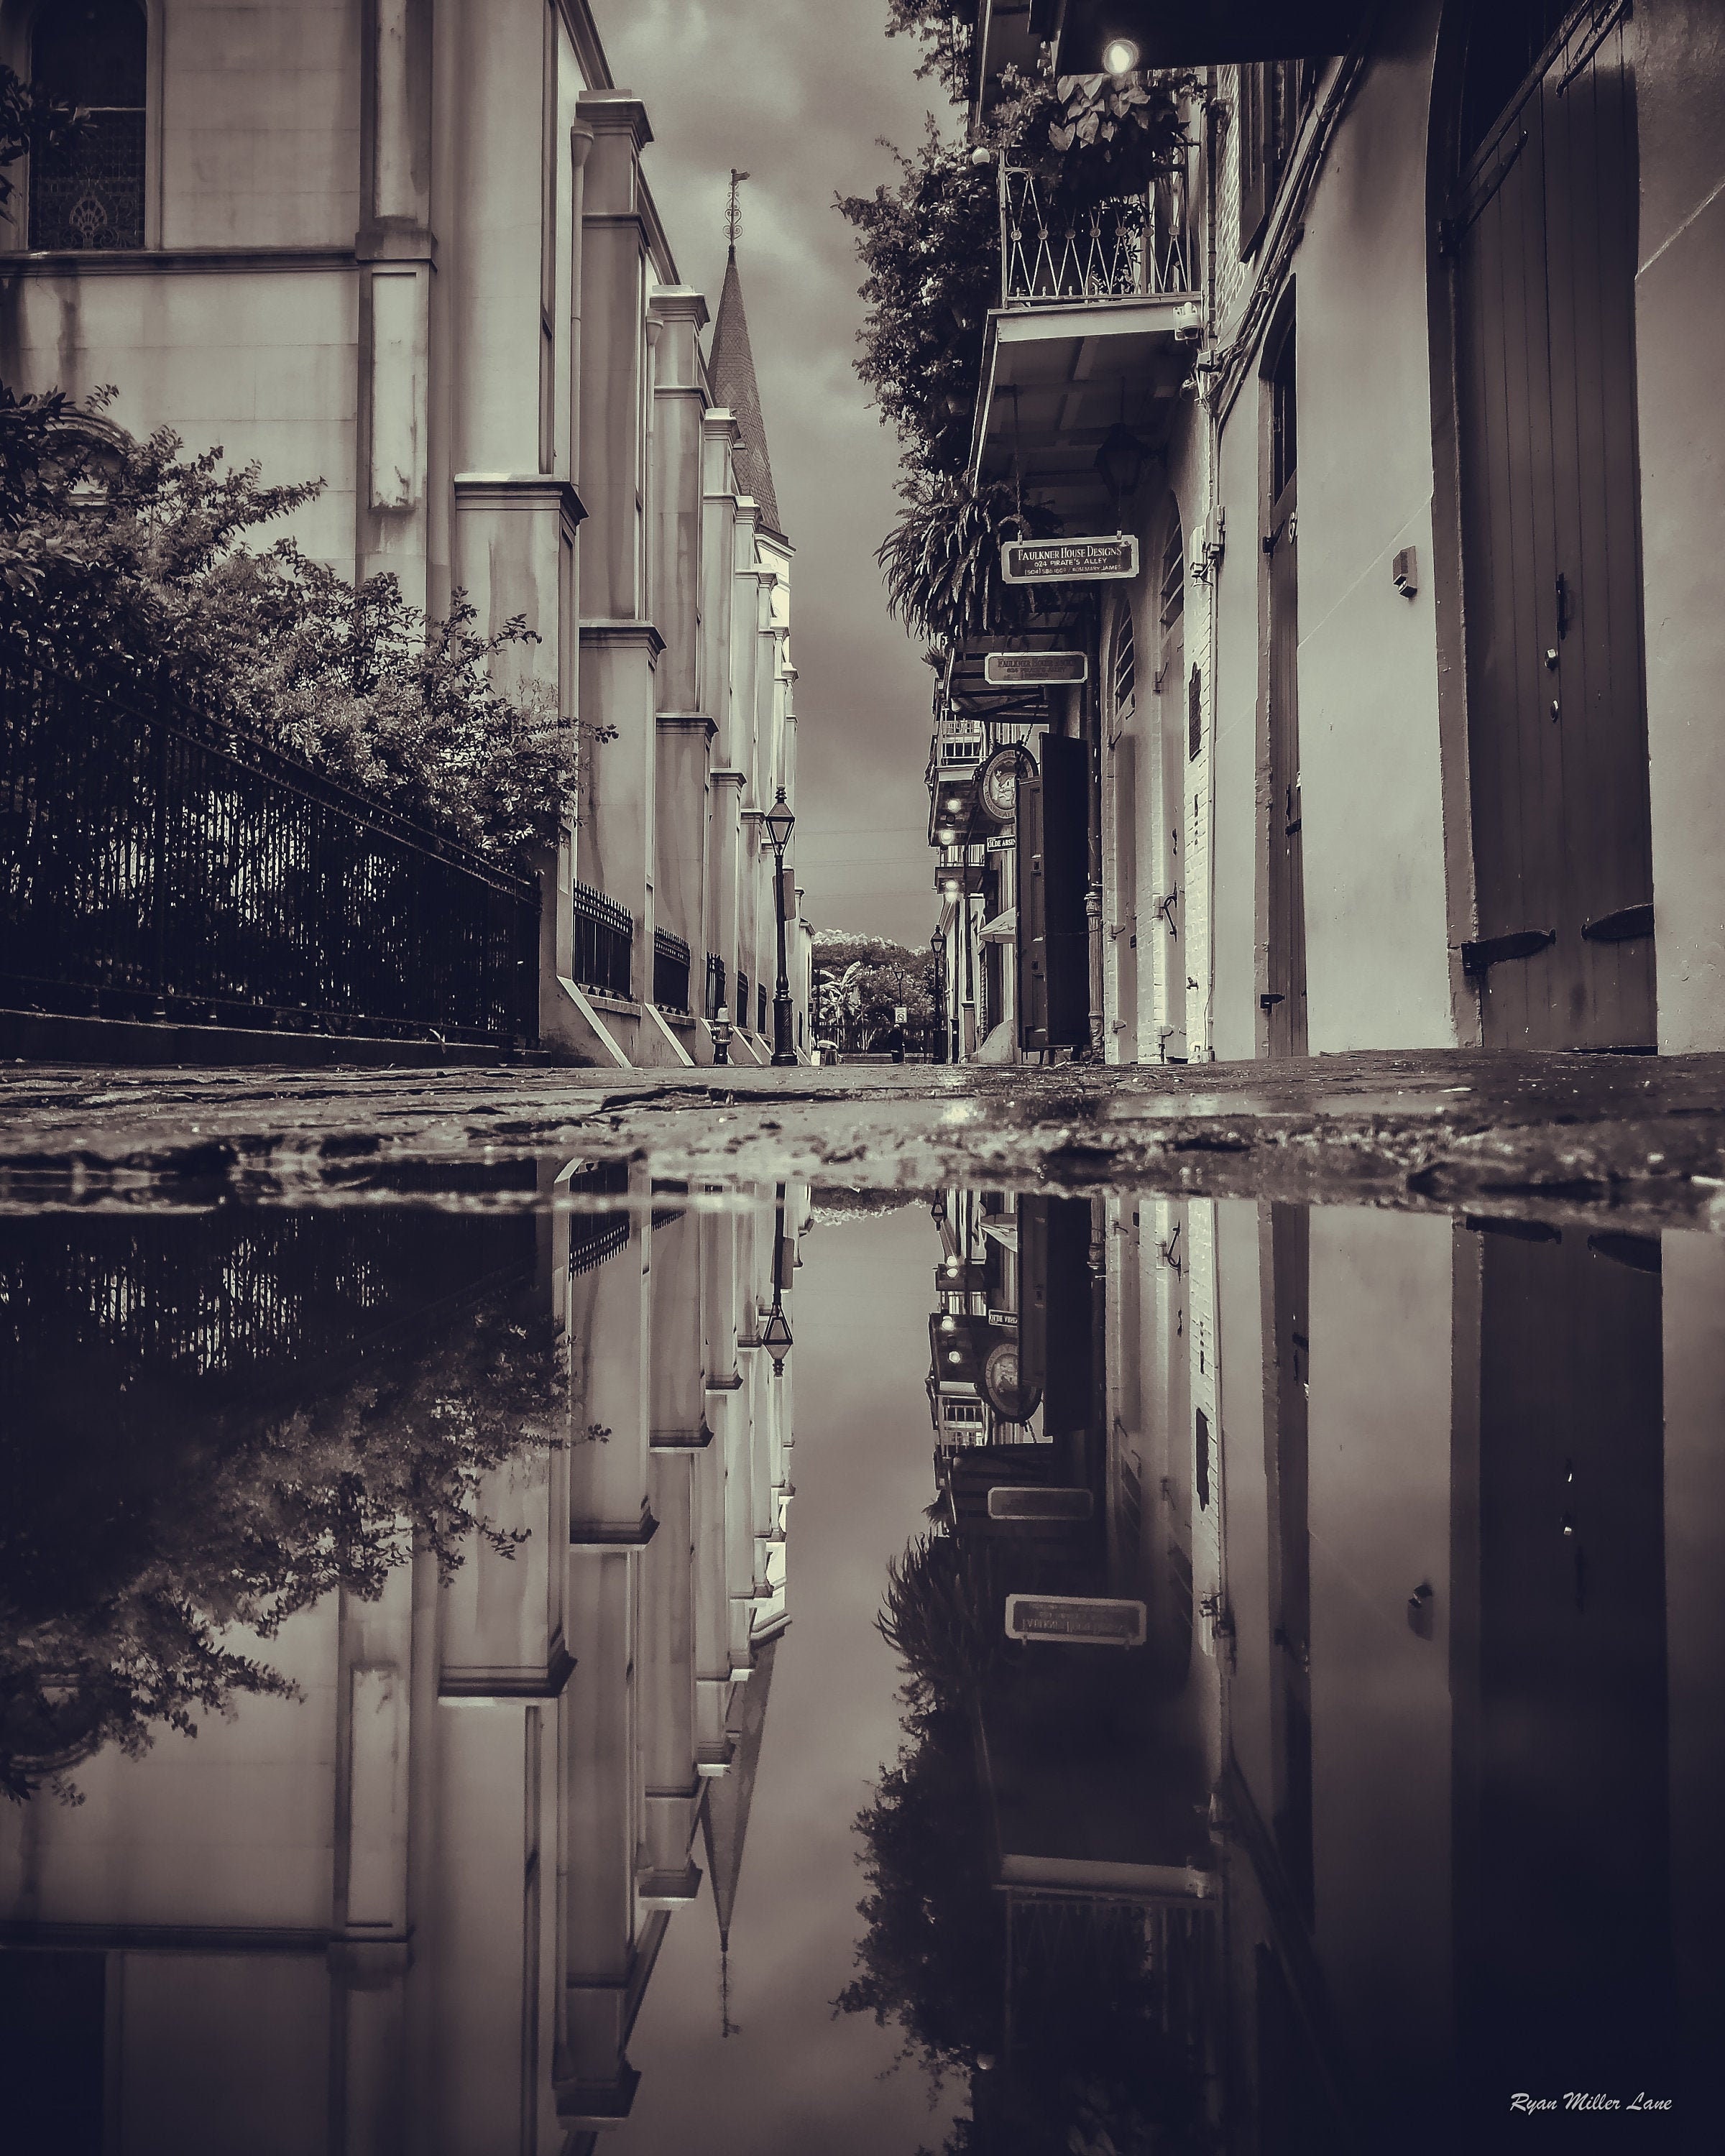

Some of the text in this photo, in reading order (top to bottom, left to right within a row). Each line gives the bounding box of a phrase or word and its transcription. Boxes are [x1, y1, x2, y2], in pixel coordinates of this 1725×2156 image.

[1018, 545, 1122, 561] FAULKNER HOUSE DESIGNS
